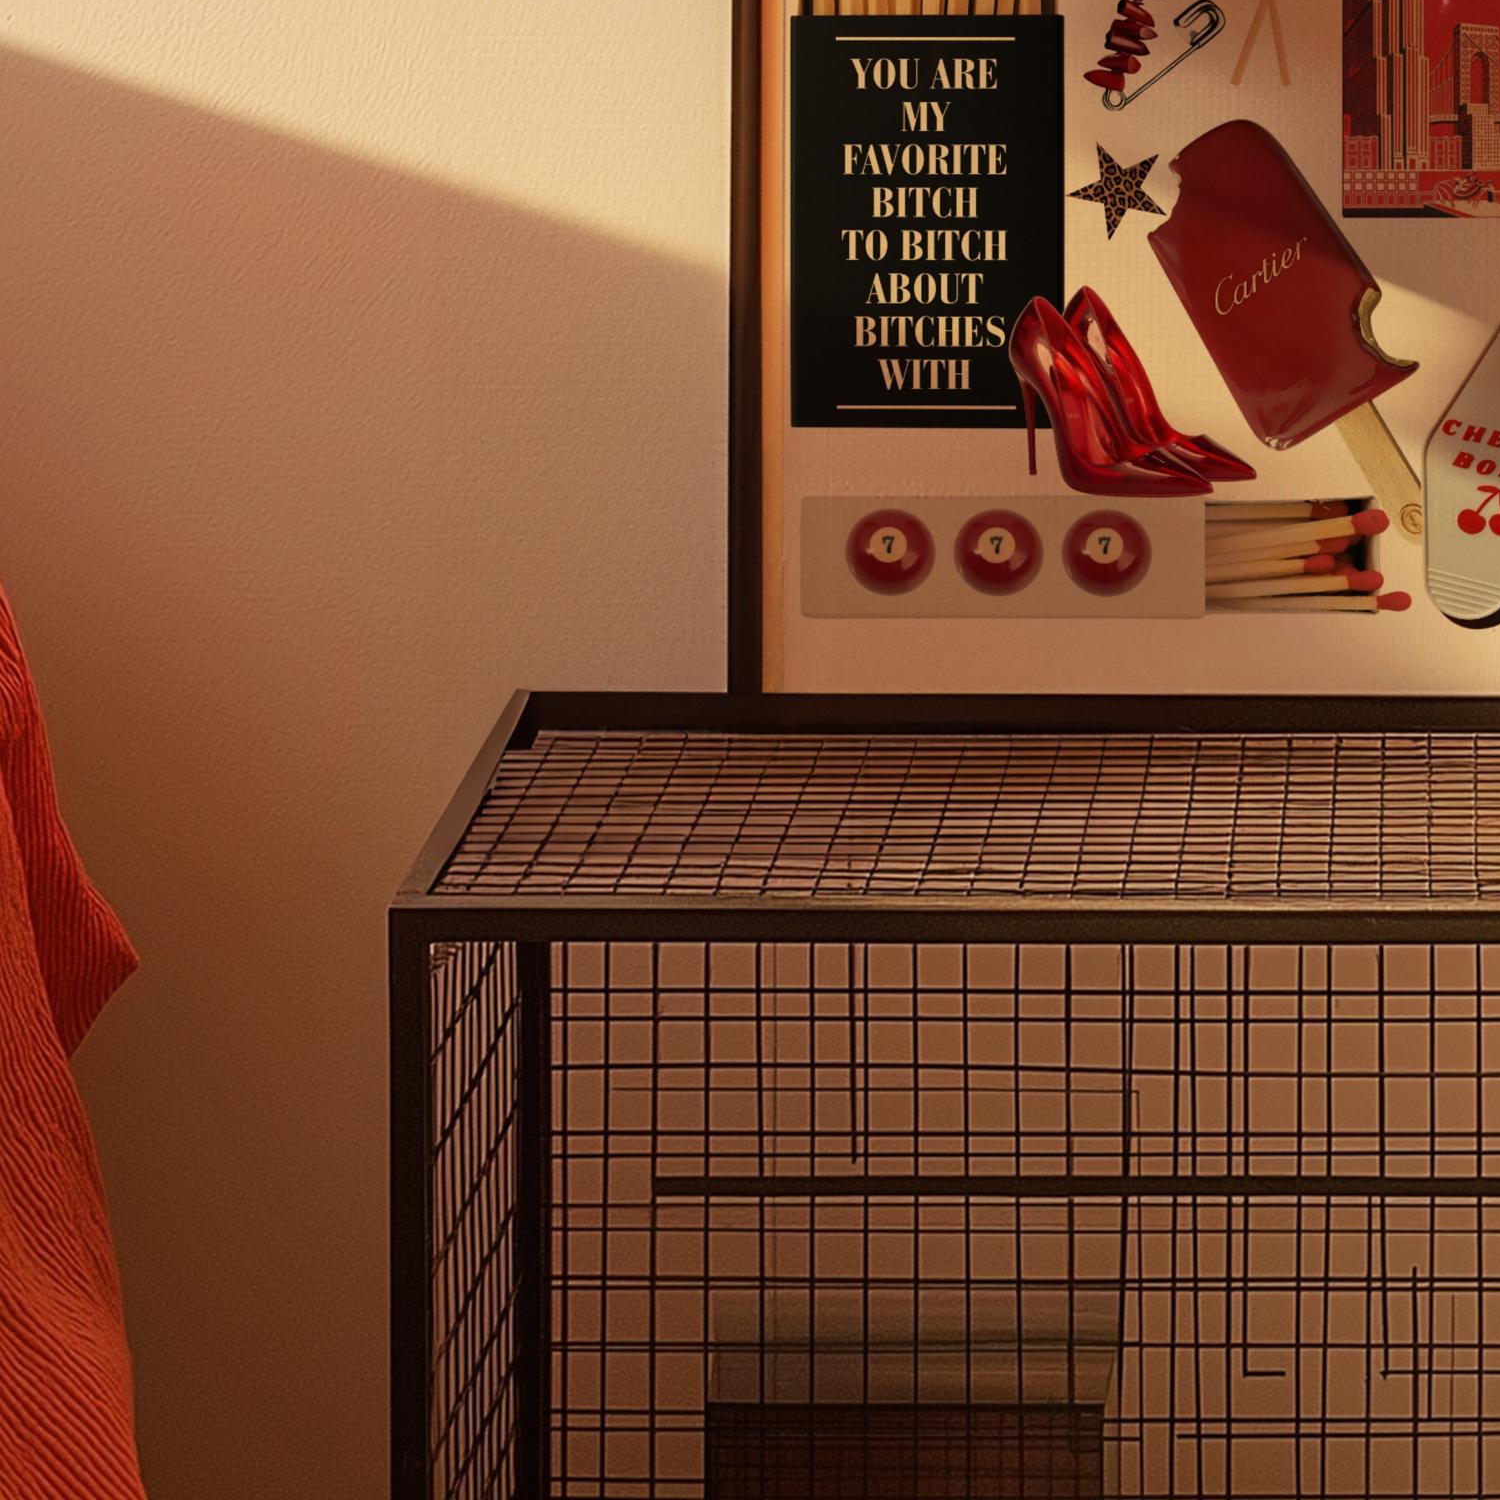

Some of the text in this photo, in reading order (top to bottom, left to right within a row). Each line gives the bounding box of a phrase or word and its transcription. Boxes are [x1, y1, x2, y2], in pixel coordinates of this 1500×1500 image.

[850, 58, 998, 90] YOU ARE
[901, 101, 951, 133] MY
[842, 143, 1008, 176] FAVORITE
[872, 186, 979, 219] BITCH
[841, 229, 1008, 262] TO BITCH
[866, 272, 984, 305] ABOUT
[1215, 236, 1307, 316] Cartier
[854, 315, 1007, 348] BITCHES
[877, 358, 972, 391] WITH
[882, 535, 895, 554] 7
[990, 535, 1003, 554] 7
[1098, 536, 1111, 555] 7
